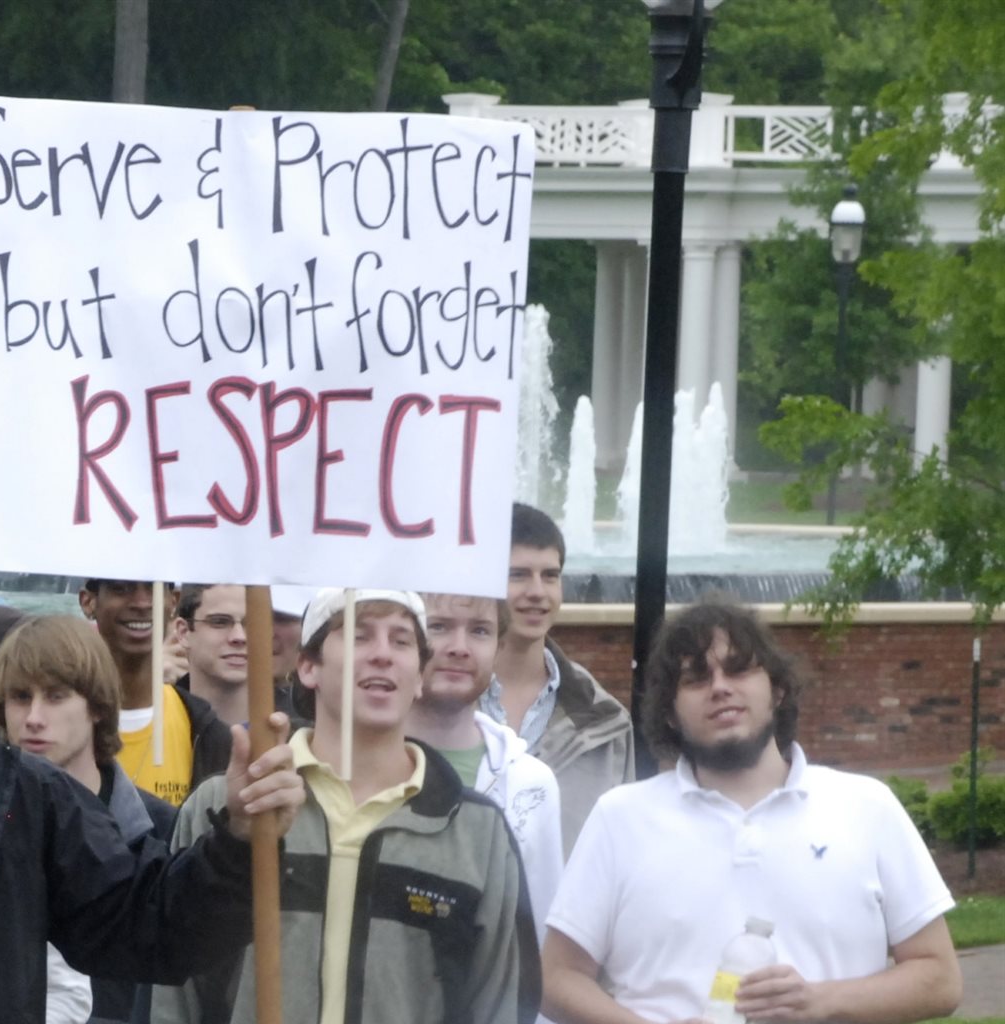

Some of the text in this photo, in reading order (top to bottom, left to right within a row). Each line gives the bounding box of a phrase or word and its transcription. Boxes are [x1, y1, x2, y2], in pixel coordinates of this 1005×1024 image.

[196, 117, 224, 230] &
[272, 115, 532, 242] Protect
[162, 237, 334, 371] don't
[345, 250, 528, 380] forget
[70, 373, 502, 546] RESPECT
